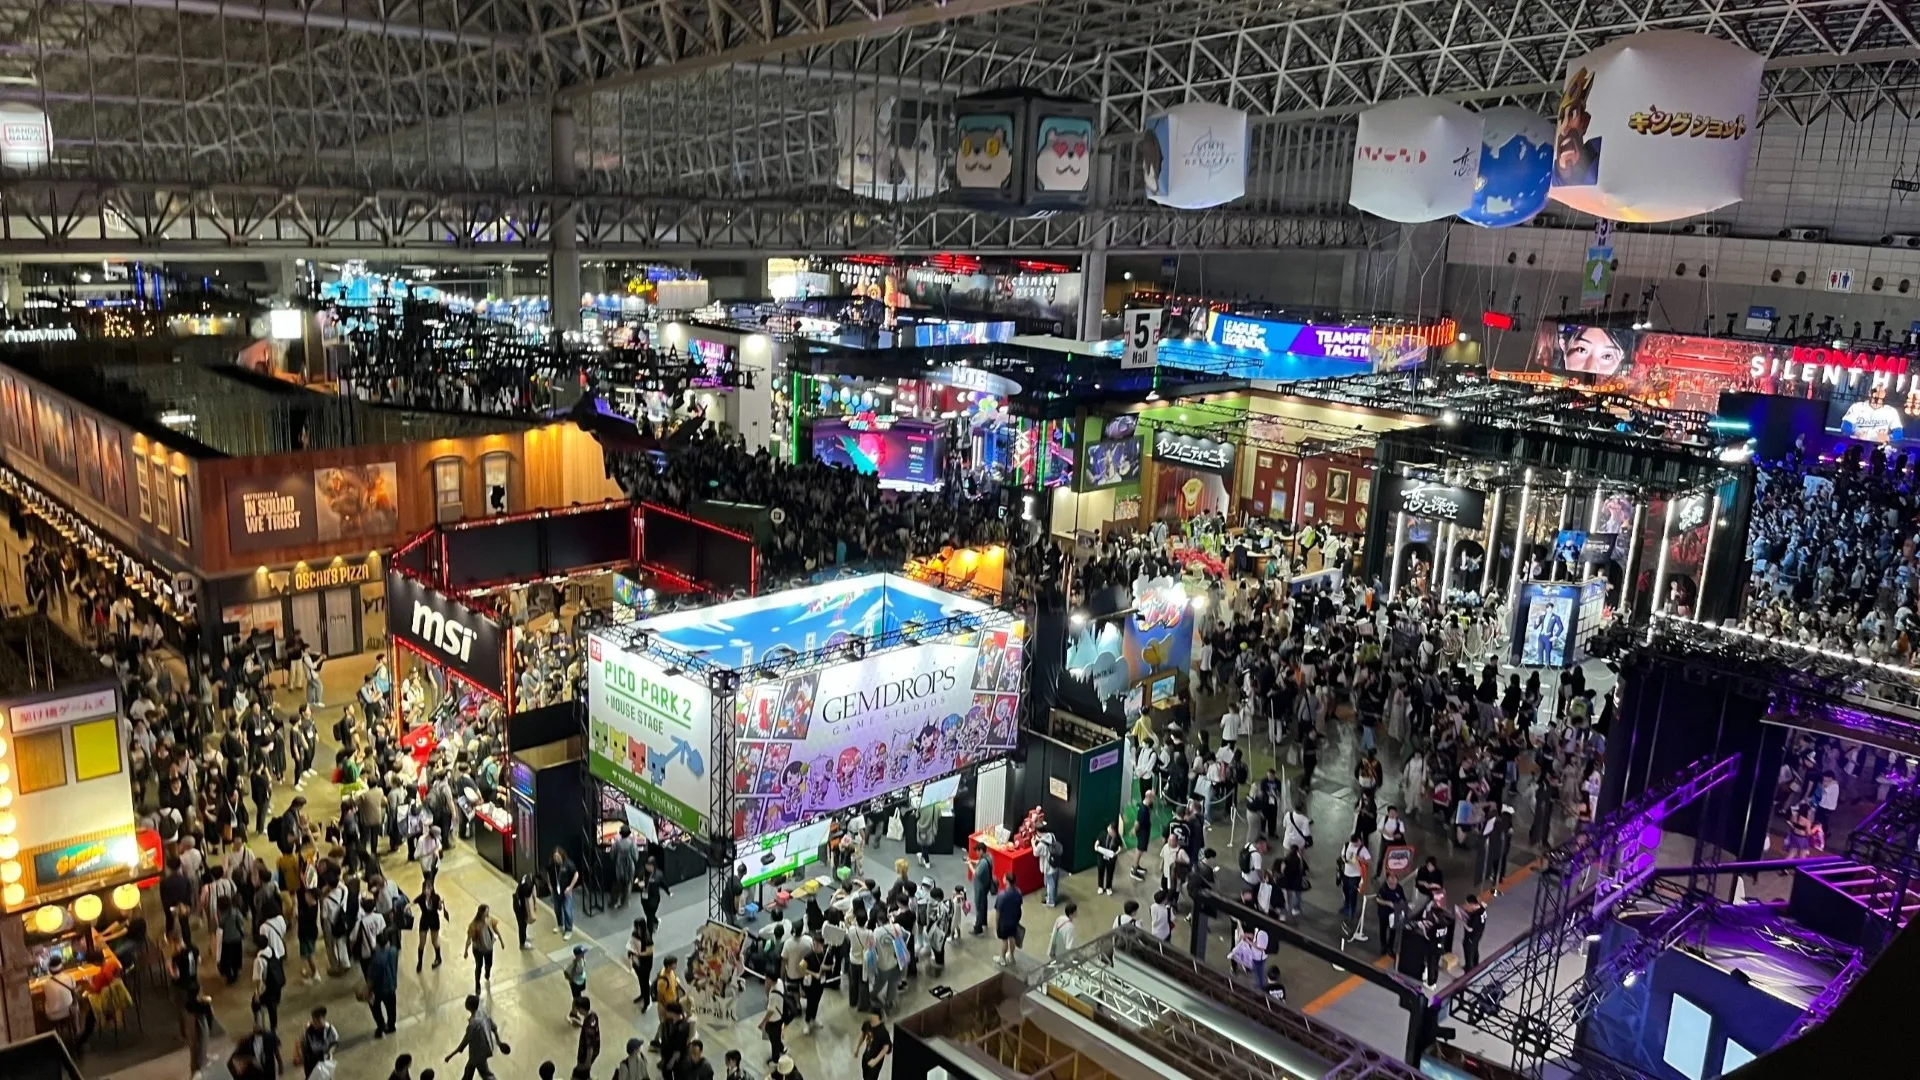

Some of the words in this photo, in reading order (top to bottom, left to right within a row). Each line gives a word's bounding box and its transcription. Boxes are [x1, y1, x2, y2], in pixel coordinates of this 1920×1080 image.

[1628, 104, 1747, 140] キングショット
[1011, 275, 1060, 286] CRIMSON
[1223, 319, 1259, 336] LEAGUE
[1764, 310, 1770, 318] 5
[1134, 313, 1150, 349] 5
[1221, 331, 1267, 350] LEGENDS
[1132, 350, 1148, 364] Hall
[1792, 346, 1909, 376] KONAMI
[1750, 356, 1864, 388] SILENT
[1856, 415, 1889, 428] Dodgers
[244, 499, 257, 517] IN
[257, 495, 295, 516] SQUAD
[1400, 481, 1459, 519] 恋と深空
[245, 515, 265, 534] WE
[265, 510, 301, 532] TRUST
[295, 567, 339, 591] OSCAR'S
[339, 563, 370, 584] PIZZA
[411, 599, 473, 664] msi
[604, 660, 636, 694] PICO
[641, 677, 679, 716] PARK
[682, 698, 692, 722] 2
[822, 665, 957, 724] GEMDROPS
[637, 712, 664, 736] STAGE
[832, 717, 875, 737] GAME
[884, 697, 947, 721] STUDIOS
